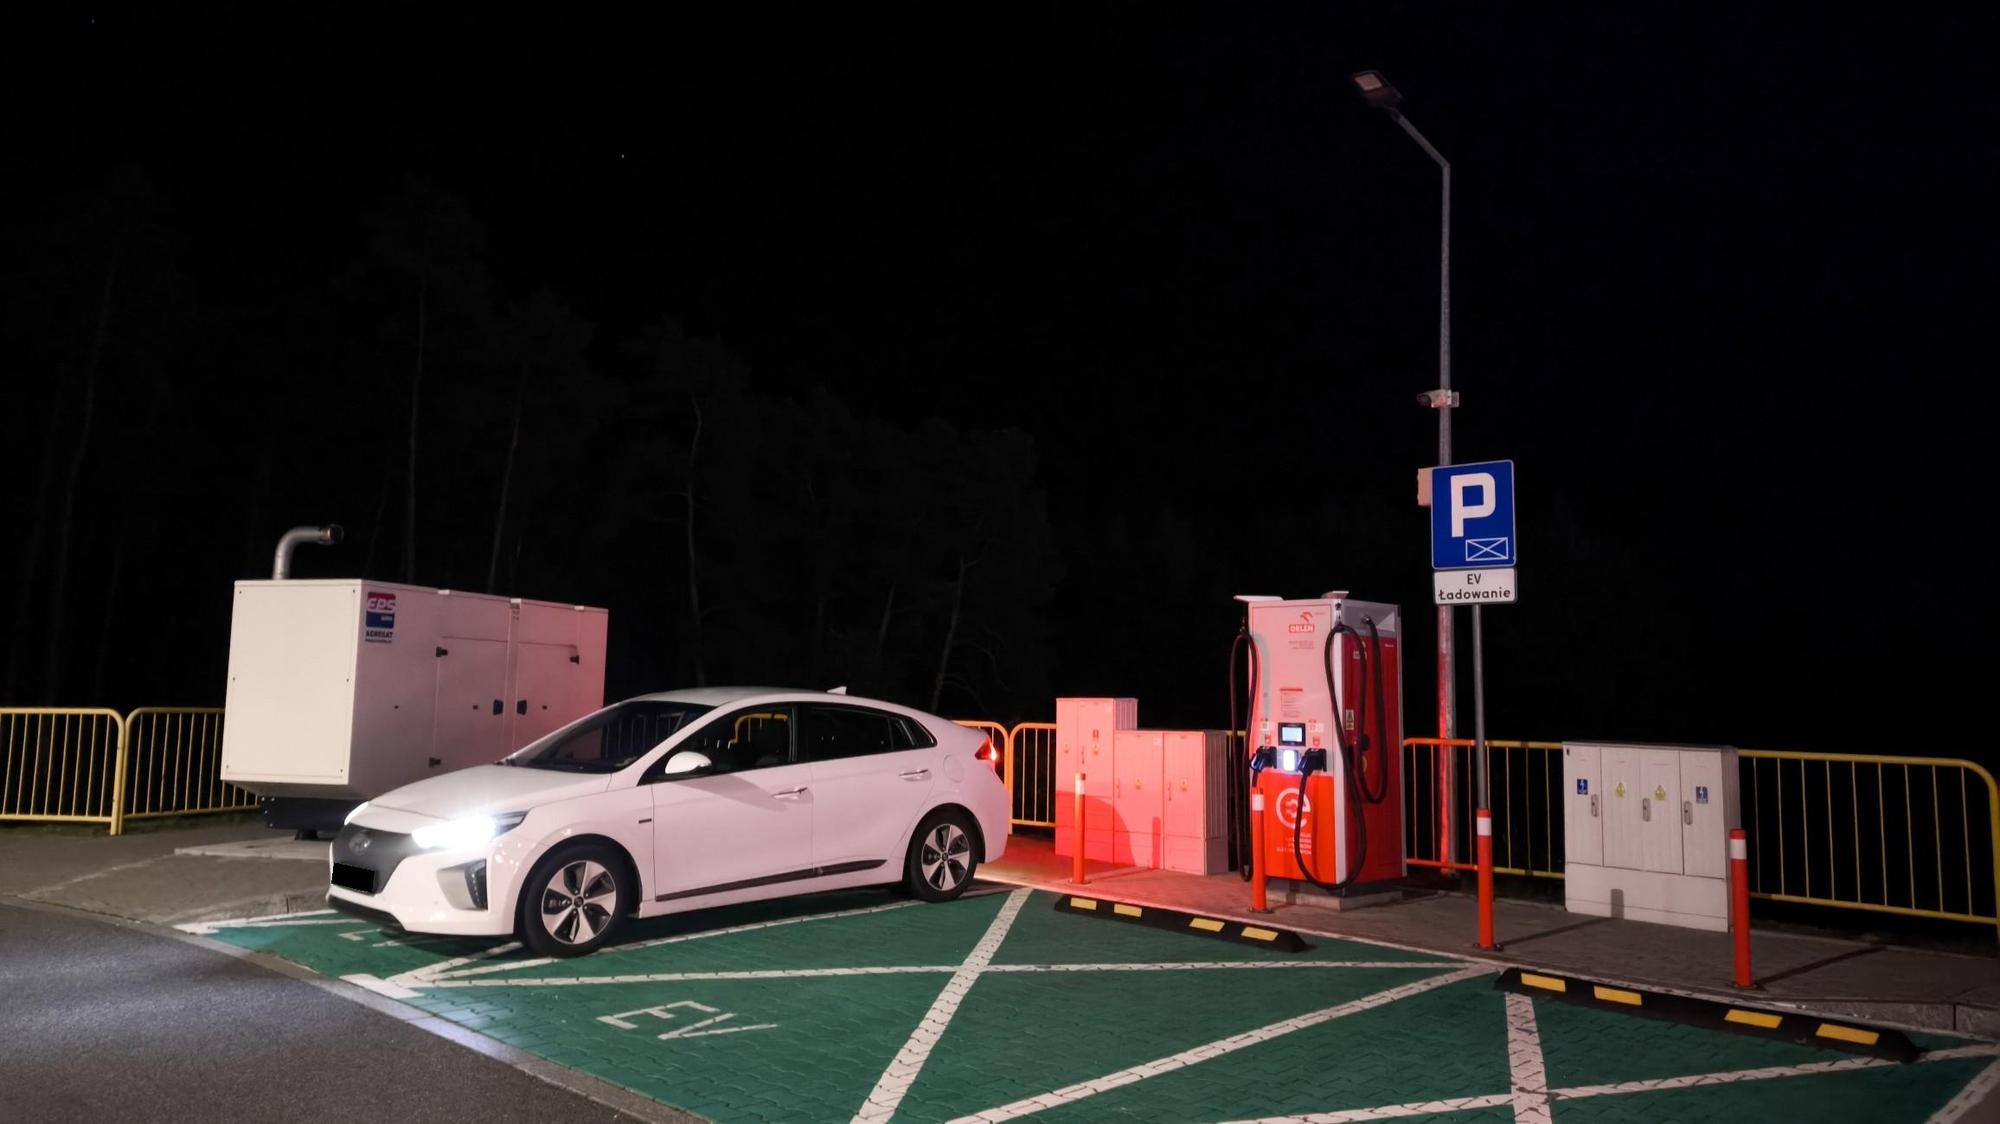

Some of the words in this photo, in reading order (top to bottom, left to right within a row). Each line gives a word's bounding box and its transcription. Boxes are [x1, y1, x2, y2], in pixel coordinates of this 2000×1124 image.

[1450, 472, 1496, 537] P
[1467, 573, 1482, 585] EV
[1438, 587, 1511, 600] Ładowanie
[596, 1000, 779, 1040] EV
